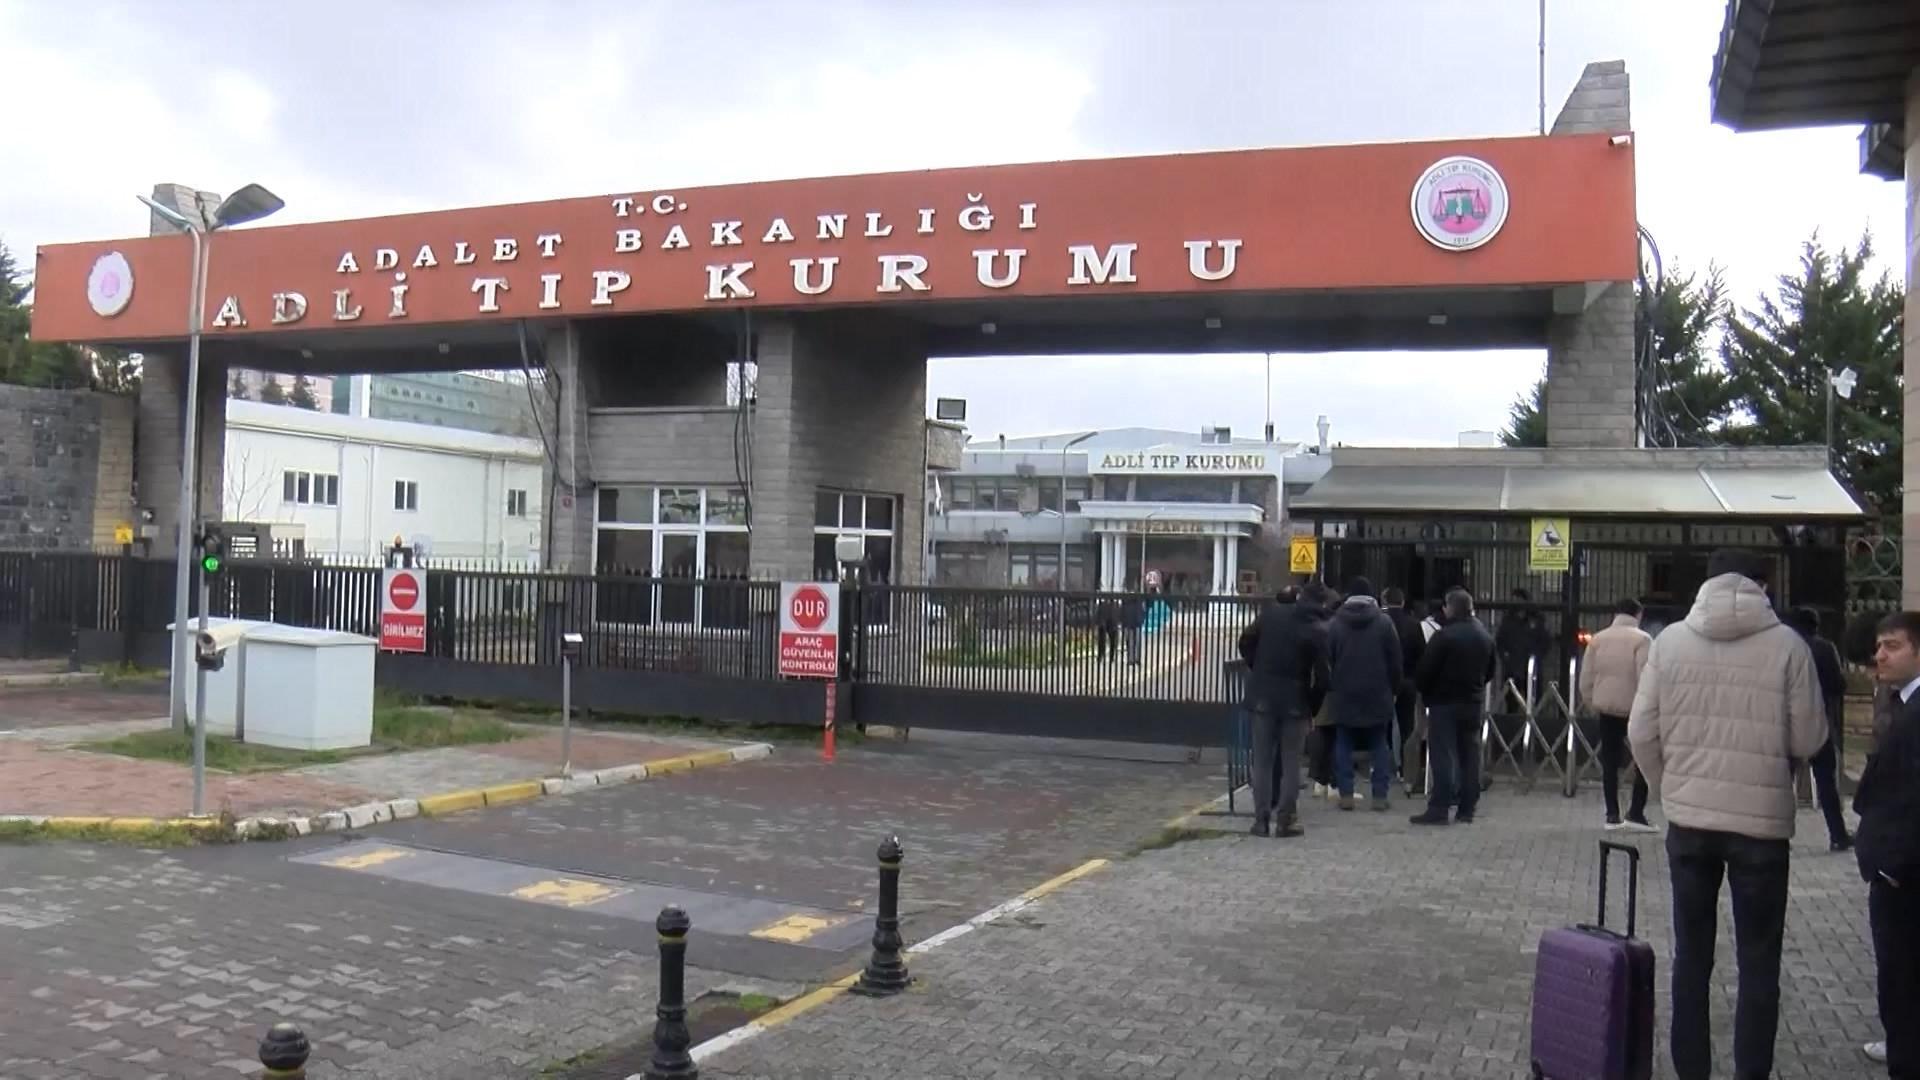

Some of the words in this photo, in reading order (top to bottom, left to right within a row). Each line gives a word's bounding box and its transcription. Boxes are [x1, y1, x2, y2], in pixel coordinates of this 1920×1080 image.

[612, 193, 688, 218] T.C.
[336, 233, 563, 274] ADALET
[614, 191, 1039, 254] BAKANLIĞI
[212, 272, 410, 329] ADLİ
[471, 270, 632, 313] TIP
[703, 238, 1243, 301] KURUMU
[1101, 451, 1145, 469] ADLİ
[1151, 455, 1180, 469] TIP
[1185, 455, 1265, 469] KURUMU
[794, 599, 825, 617] DUR
[384, 623, 424, 638] GİRİLMEZ
[795, 637, 823, 648] ARAÇ
[783, 647, 834, 659] GÜVENLİK
